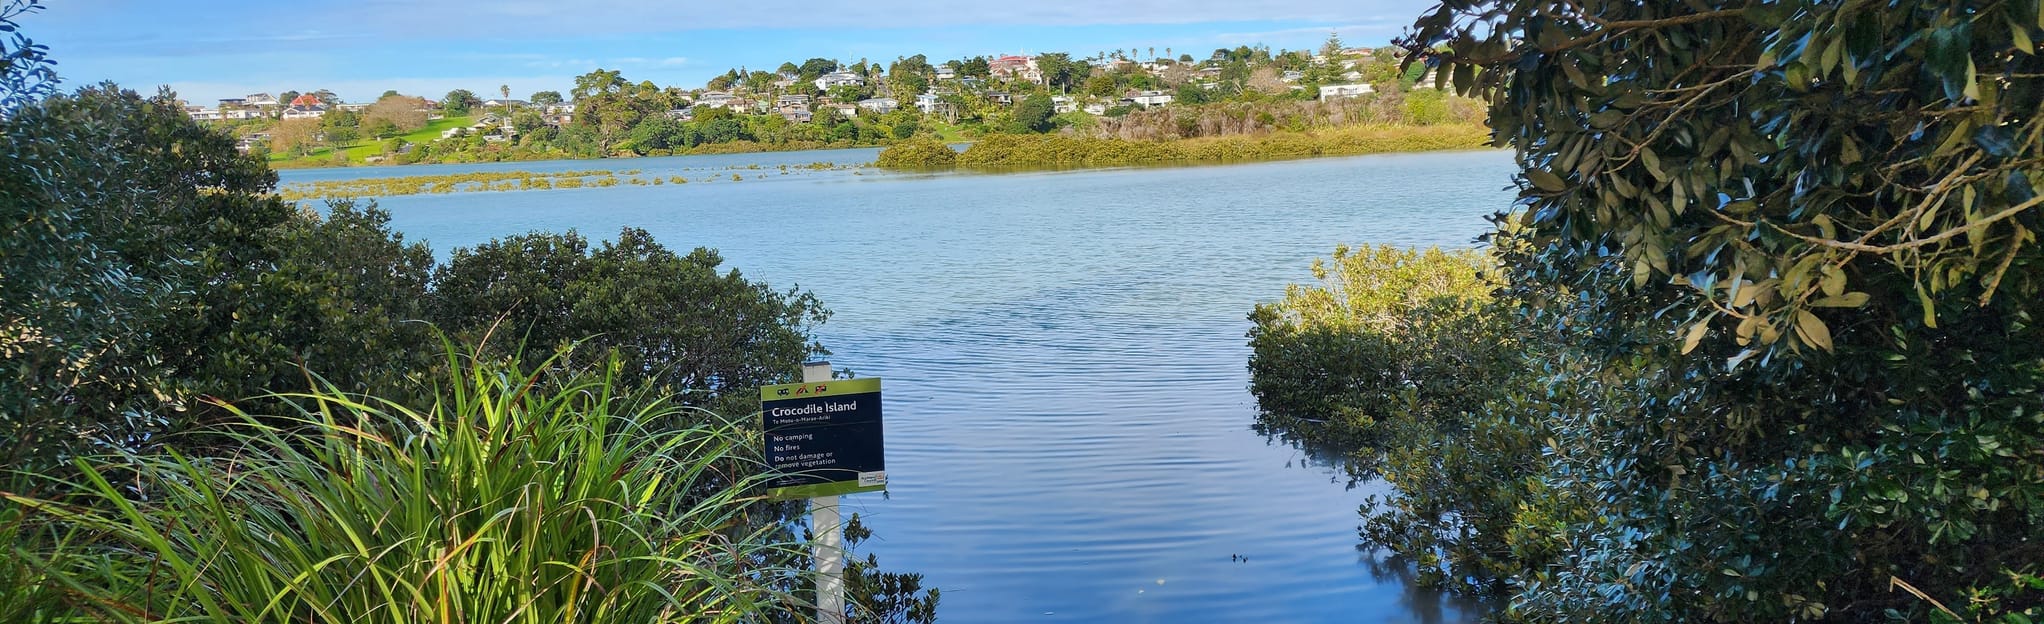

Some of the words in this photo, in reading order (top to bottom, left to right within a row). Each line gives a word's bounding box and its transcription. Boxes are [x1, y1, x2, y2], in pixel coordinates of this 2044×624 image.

[772, 403, 823, 417] Crocodile
[825, 400, 857, 412] Island
[784, 433, 813, 441] camping
[800, 458, 836, 467] vegetation
